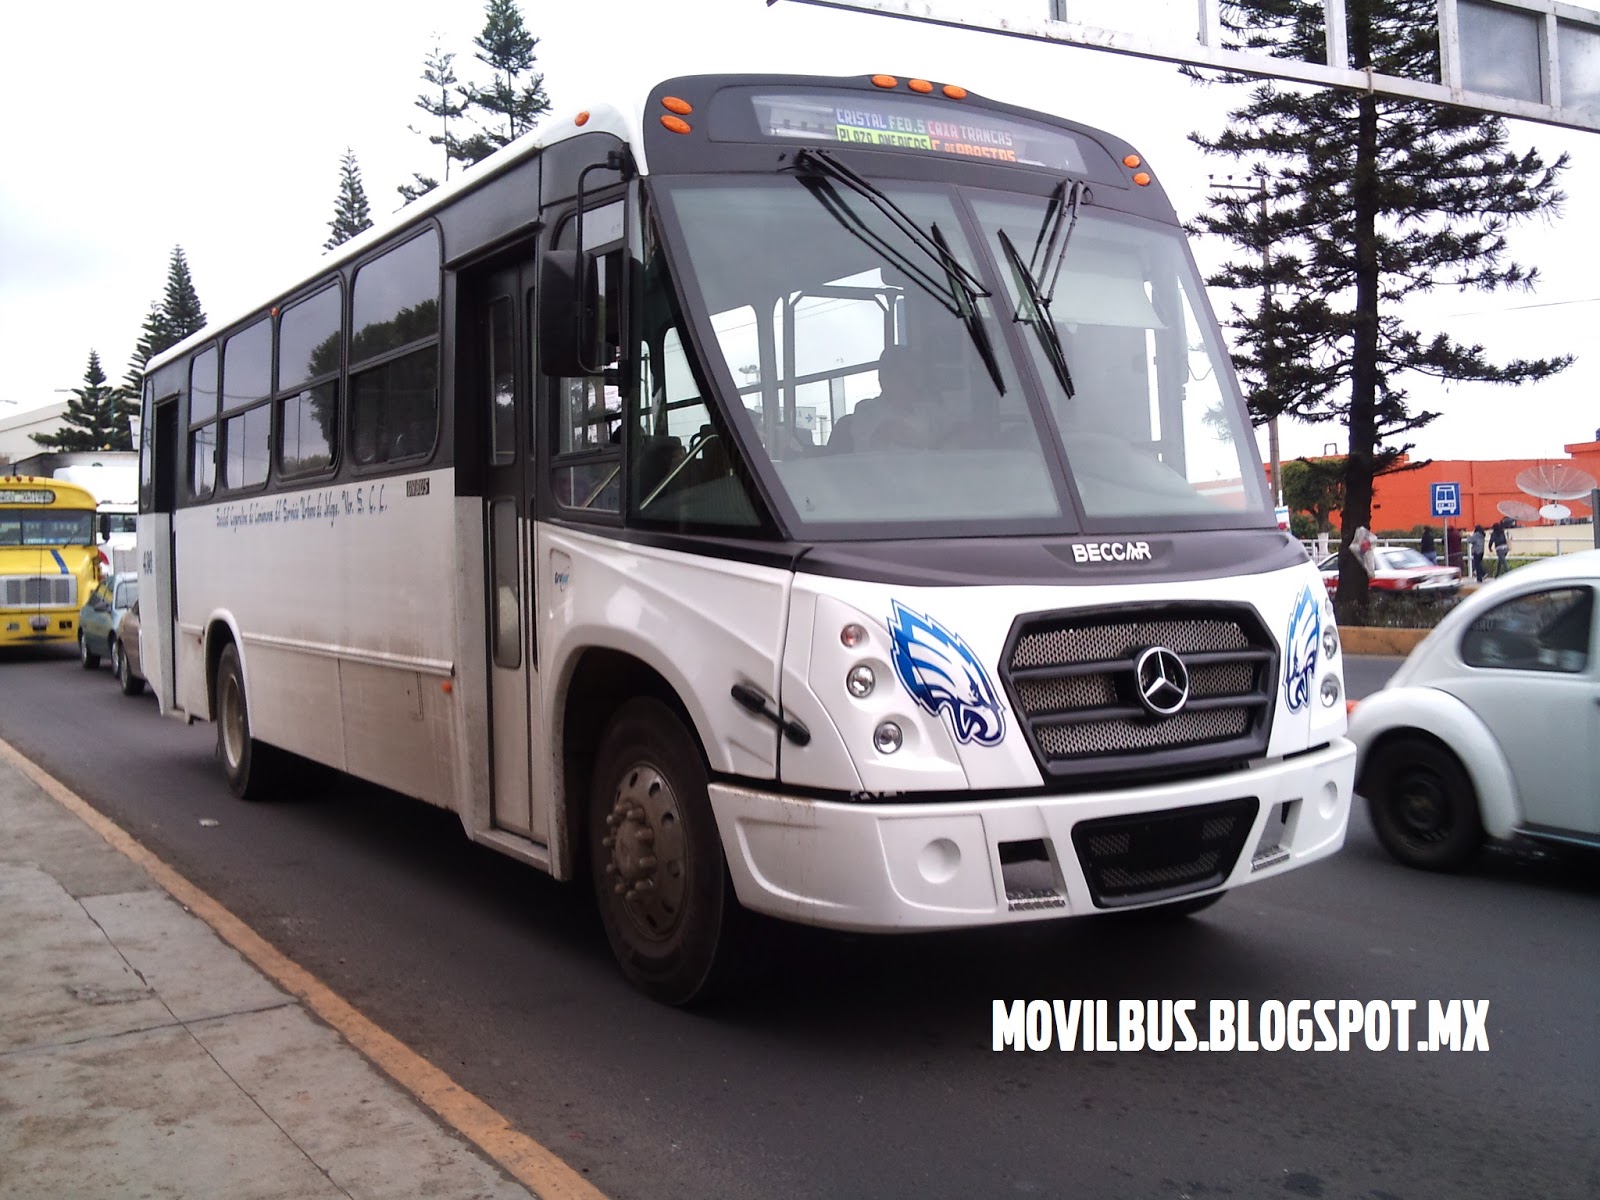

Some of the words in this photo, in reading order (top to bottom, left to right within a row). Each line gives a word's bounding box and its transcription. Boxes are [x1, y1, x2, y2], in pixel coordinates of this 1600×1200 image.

[836, 108, 887, 129] CRISTAL
[960, 125, 1013, 146] TRANCAS
[1071, 541, 1152, 563] BECCAR
